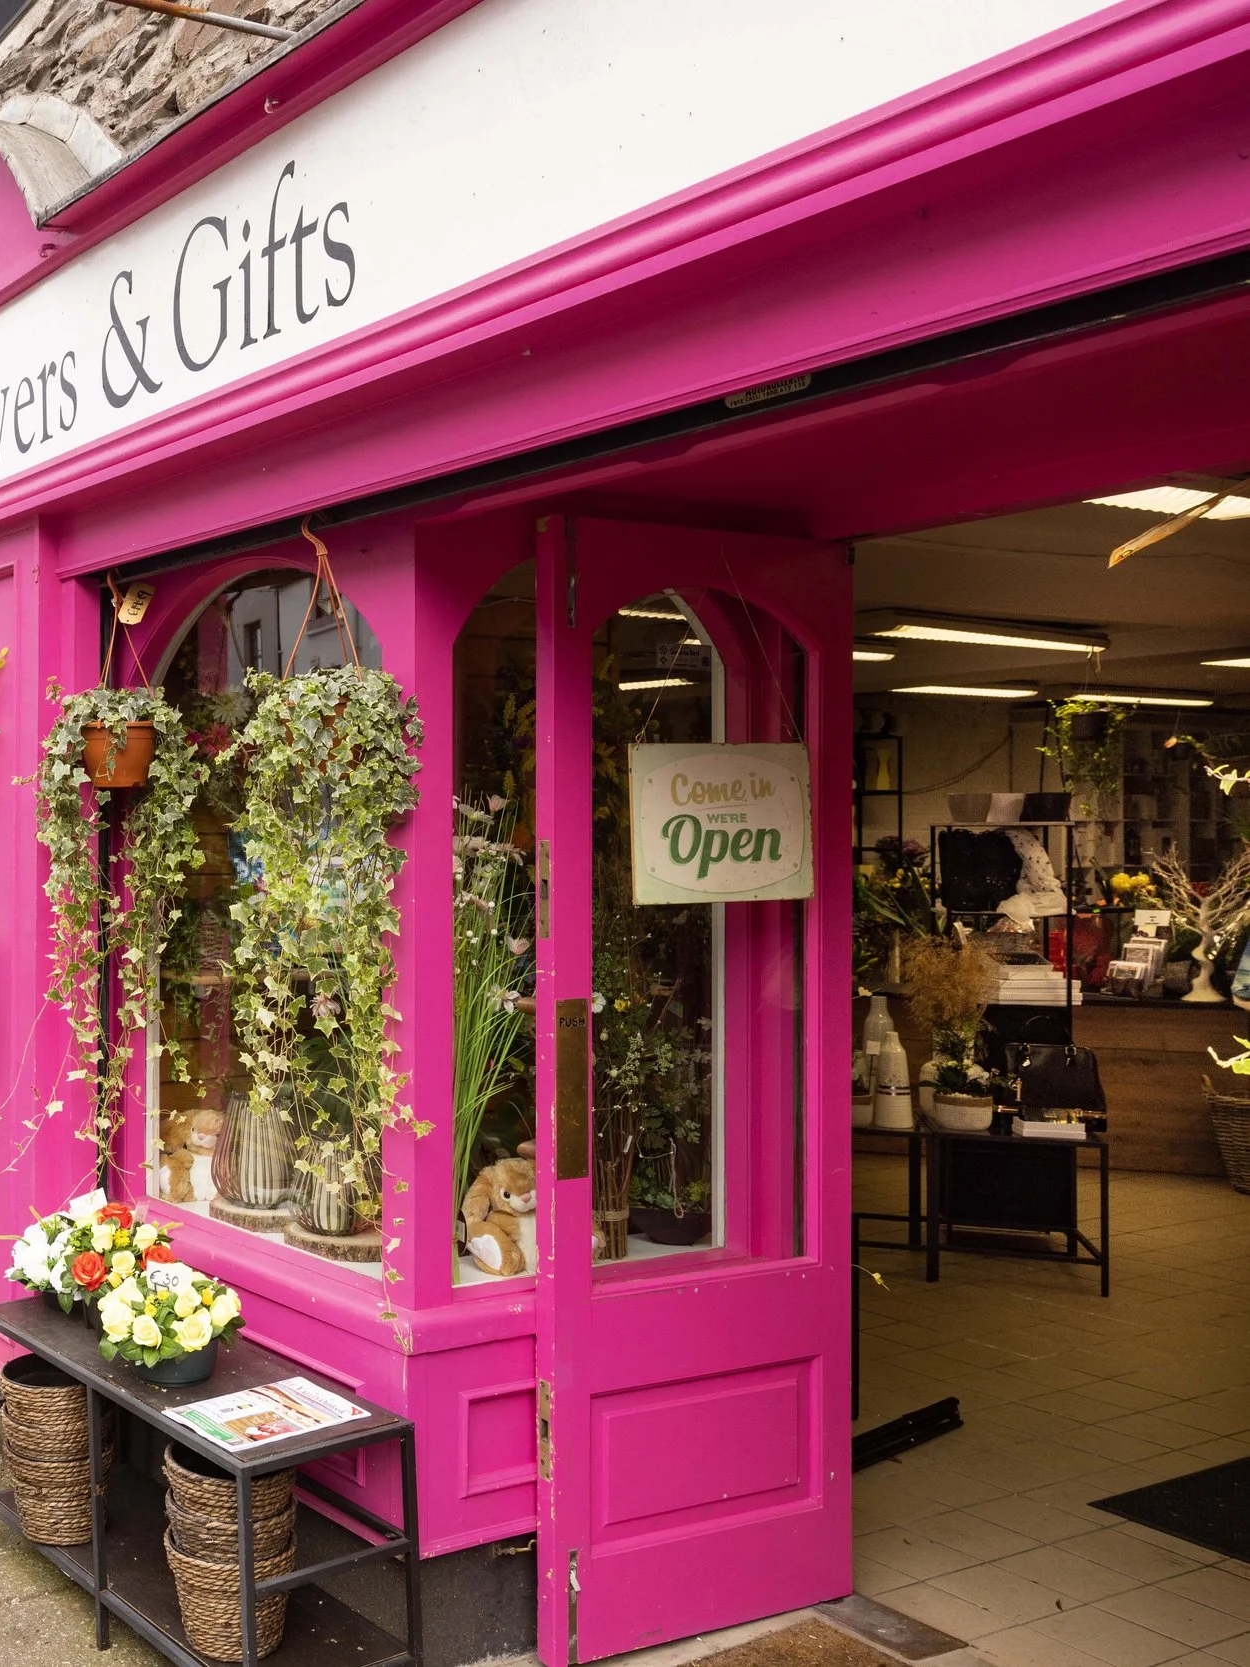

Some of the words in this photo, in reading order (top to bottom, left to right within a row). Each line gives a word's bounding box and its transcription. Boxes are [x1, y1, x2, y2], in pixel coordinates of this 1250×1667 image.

[100, 270, 162, 408] &
[172, 160, 356, 372] Gifts
[670, 772, 747, 807] Come
[749, 771, 776, 801] in
[706, 812, 748, 824] WE'RE
[660, 813, 783, 881] Open
[559, 1017, 586, 1028] PUSH
